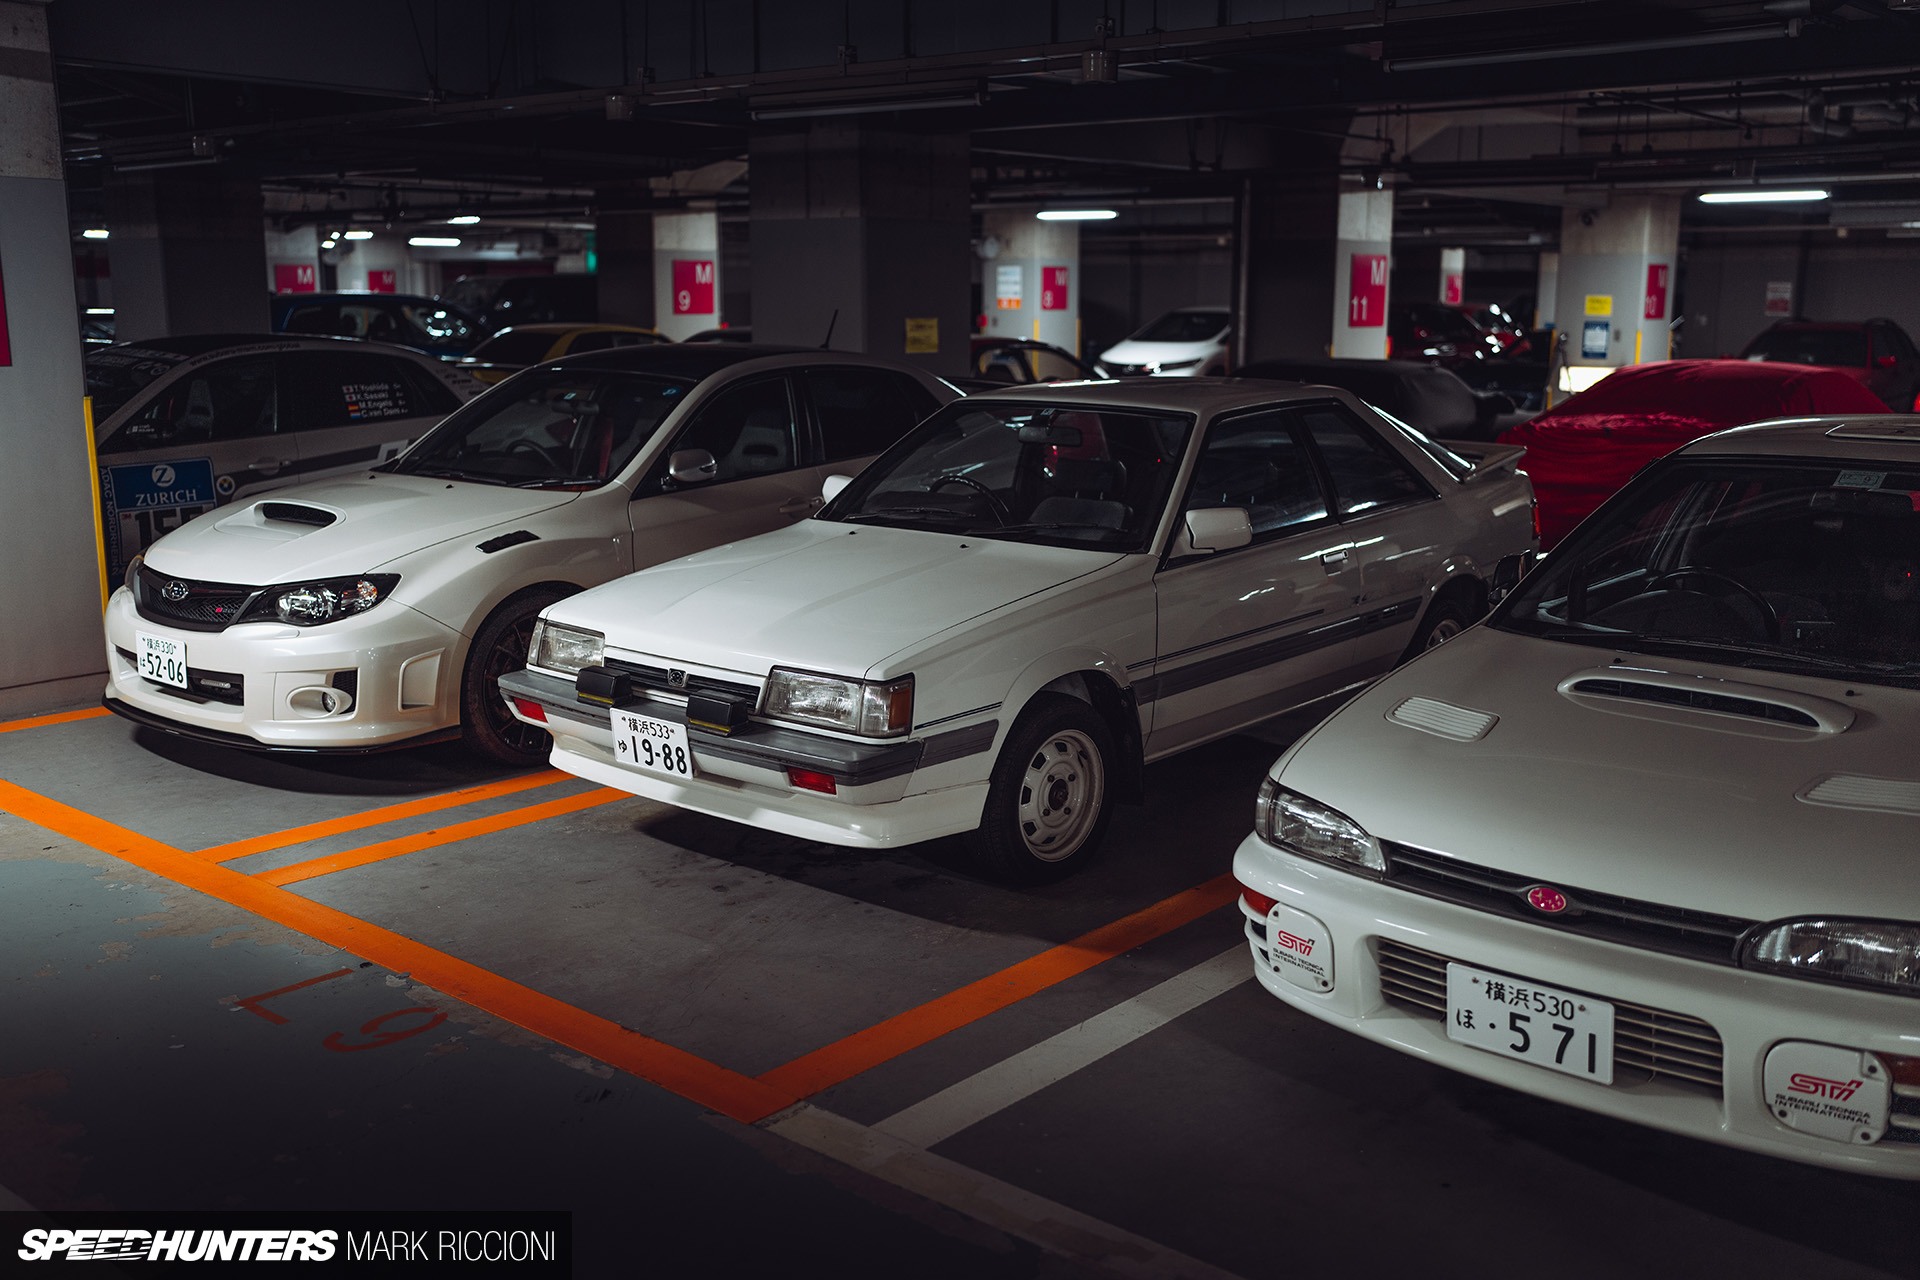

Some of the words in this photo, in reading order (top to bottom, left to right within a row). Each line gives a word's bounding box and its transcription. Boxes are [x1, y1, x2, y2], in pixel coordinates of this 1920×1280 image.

[297, 266, 314, 285] M
[695, 262, 713, 285] M
[1371, 259, 1385, 286] M
[678, 289, 691, 311] 9
[1351, 295, 1368, 322] 11
[99, 467, 114, 499] ADAC
[135, 488, 198, 507] ZURICH
[105, 500, 122, 568] NORDRHEIN
[146, 652, 184, 683] 52-06
[628, 717, 670, 740] 横浜533
[631, 735, 687, 774] 19-88
[1272, 947, 1297, 961] SUBARU
[1298, 957, 1325, 972] TECNICA
[1272, 952, 1326, 978] INTERNATIONAL
[1485, 979, 1575, 1021] 横浜530
[1456, 1008, 1476, 1030] ほ
[1774, 1099, 1872, 1125] INTERNATIONAL
[1776, 1093, 1821, 1109] SUBARU
[1823, 1103, 1871, 1119] TECNICA
